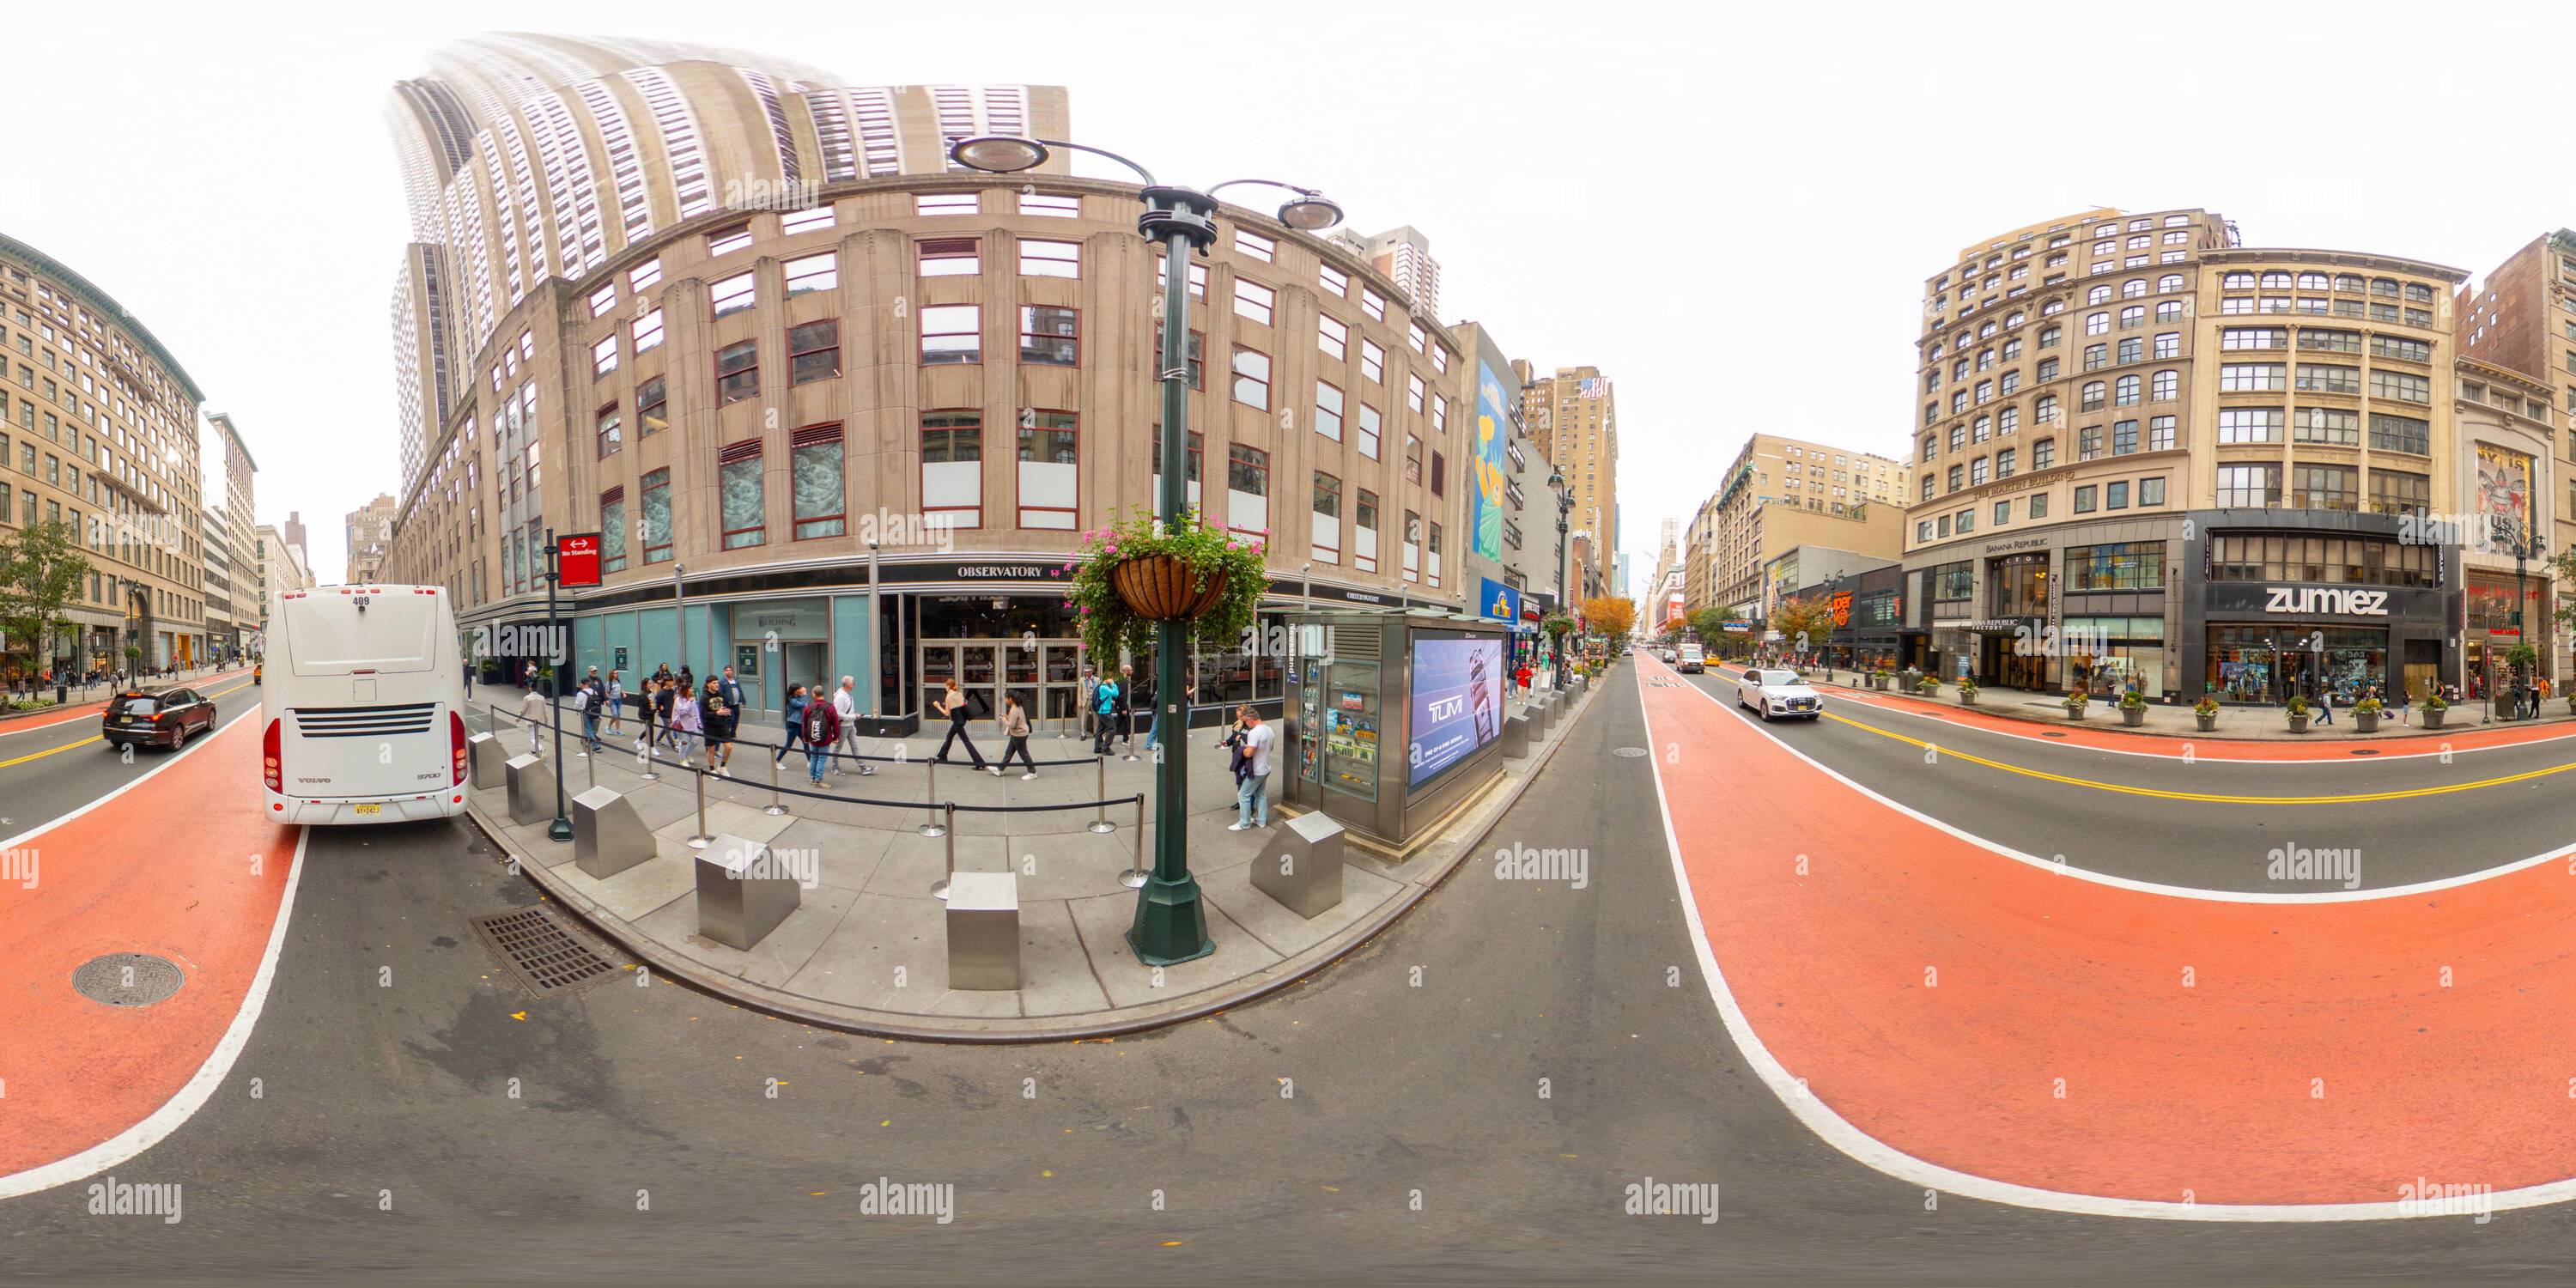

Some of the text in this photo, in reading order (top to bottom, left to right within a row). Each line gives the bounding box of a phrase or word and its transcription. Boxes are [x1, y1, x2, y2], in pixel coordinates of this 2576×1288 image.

[2478, 451, 2497, 464] NY
[1973, 471, 2075, 500] THE MARTIN BUILDING
[1986, 538, 2048, 553] BANANA REPUBLIC
[957, 566, 1042, 577] OBSERVATORY
[759, 617, 796, 627] BUILDING
[1429, 694, 1462, 724] TUMI
[811, 720, 821, 742] VANS
